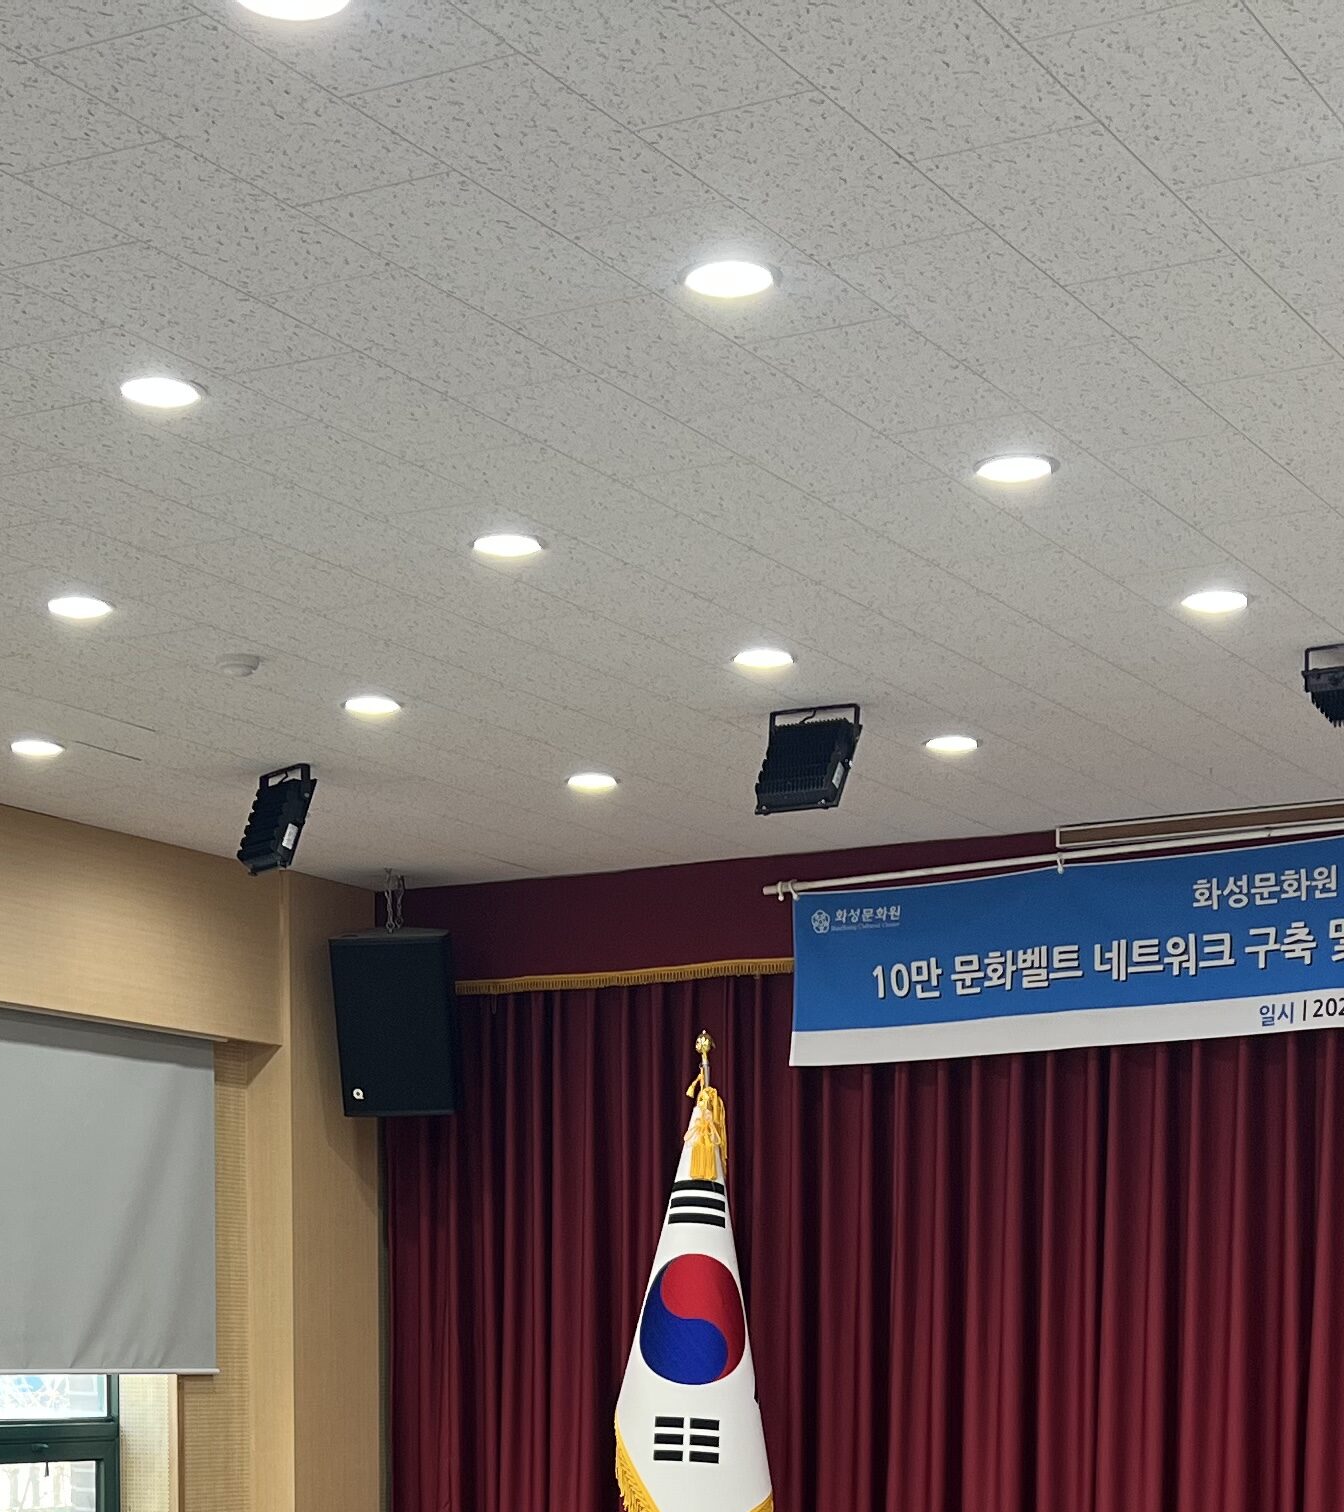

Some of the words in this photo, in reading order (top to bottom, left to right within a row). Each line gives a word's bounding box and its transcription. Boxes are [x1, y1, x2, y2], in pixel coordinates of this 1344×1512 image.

[1193, 864, 1338, 910] 화성문화원
[834, 905, 901, 924] 화성문화원
[872, 957, 943, 999] 10만
[951, 944, 1084, 995] 문화벨트
[1094, 932, 1236, 982] 네트워크
[1244, 920, 1318, 970] 구축
[1258, 1001, 1295, 1027] 일시
